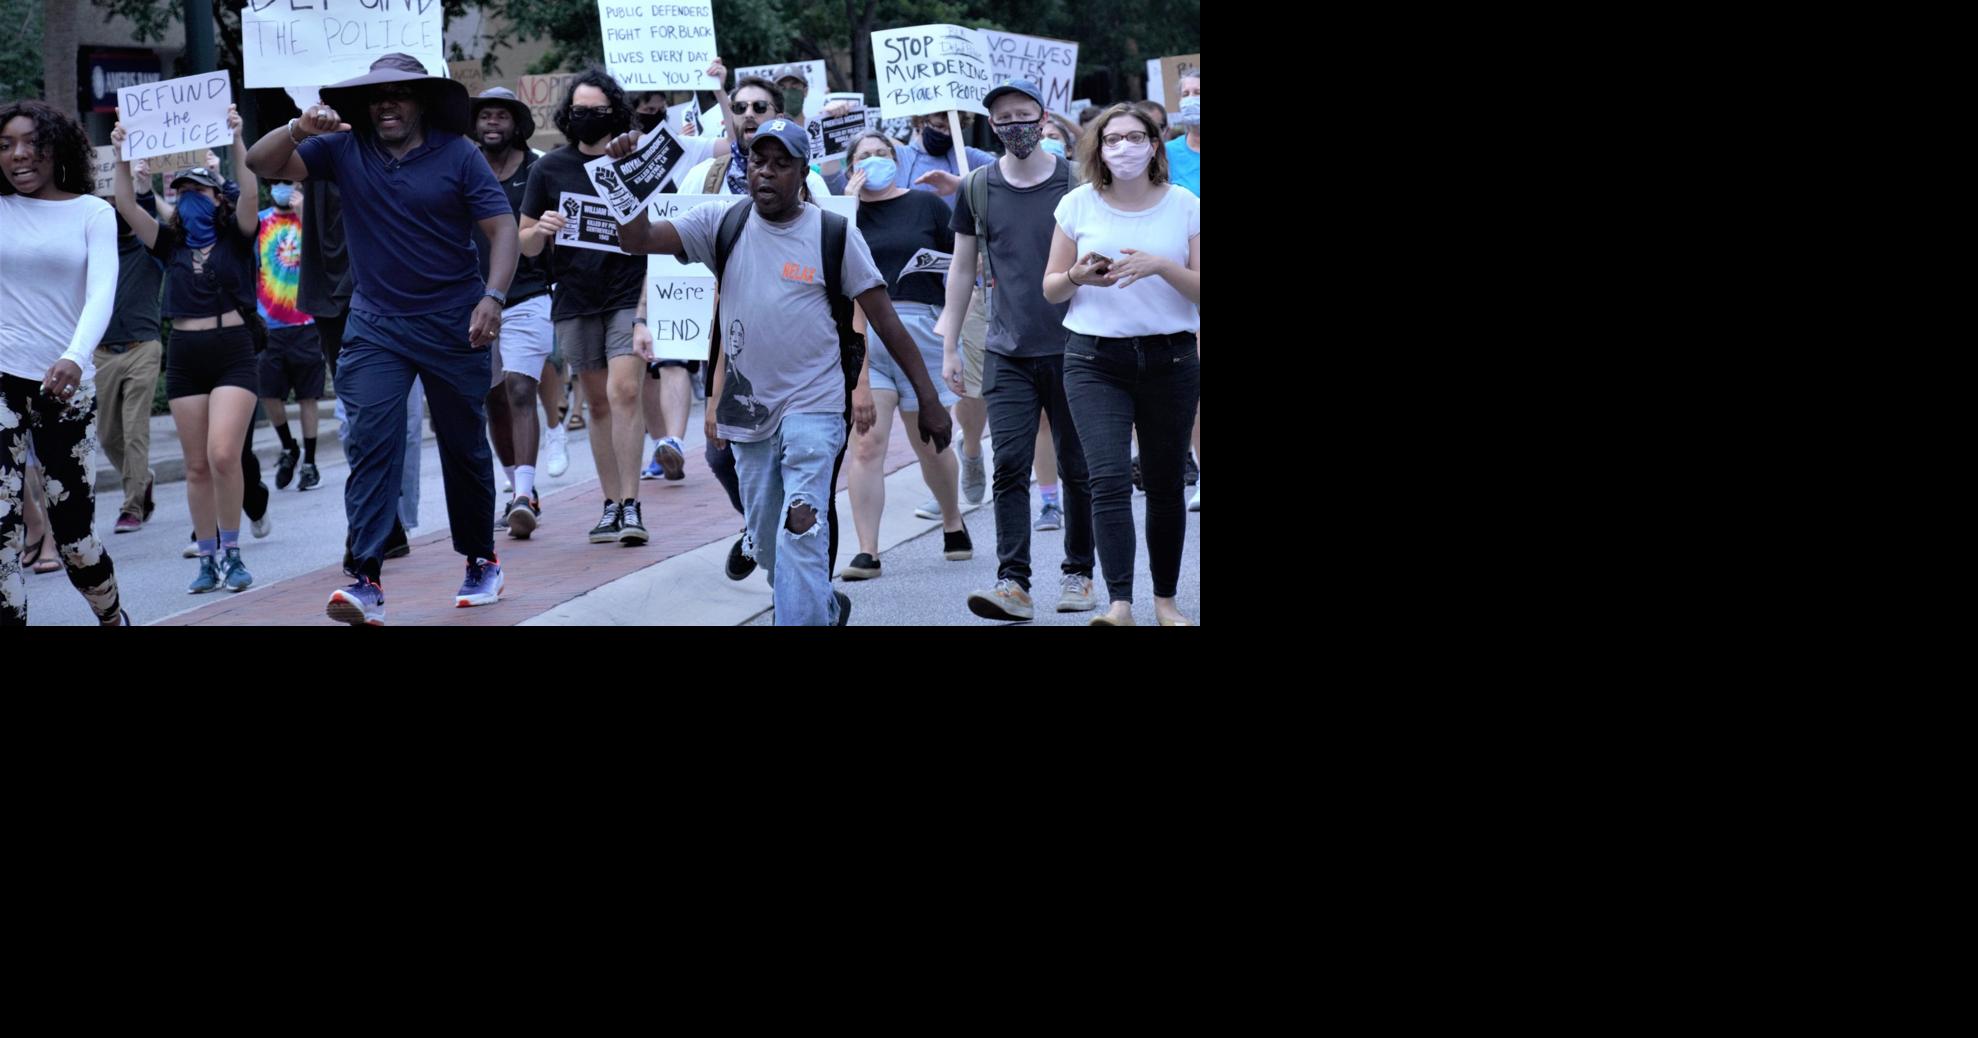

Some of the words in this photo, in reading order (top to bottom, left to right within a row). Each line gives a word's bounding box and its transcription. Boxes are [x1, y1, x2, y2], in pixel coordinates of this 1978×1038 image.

[606, 6, 643, 18] PUBLIC
[652, 5, 709, 17] DEFENDERS
[245, 20, 308, 56] THE
[323, 17, 433, 54] POLICE
[607, 28, 641, 41] FIGHT
[651, 26, 677, 39] FOR
[679, 25, 712, 39] BLACK
[609, 52, 644, 64] LIVES
[651, 50, 683, 62] EVERY
[688, 51, 708, 62] DAY
[884, 36, 934, 63] STOP
[1024, 41, 1071, 66] LIVES
[620, 72, 657, 84] WILL
[886, 59, 988, 83] MURDERING
[125, 78, 226, 117] DEFUND
[163, 111, 191, 127] the
[619, 157, 645, 176] ROYAL
[653, 200, 679, 218] We
[655, 282, 704, 300] We're
[657, 318, 700, 341] END
